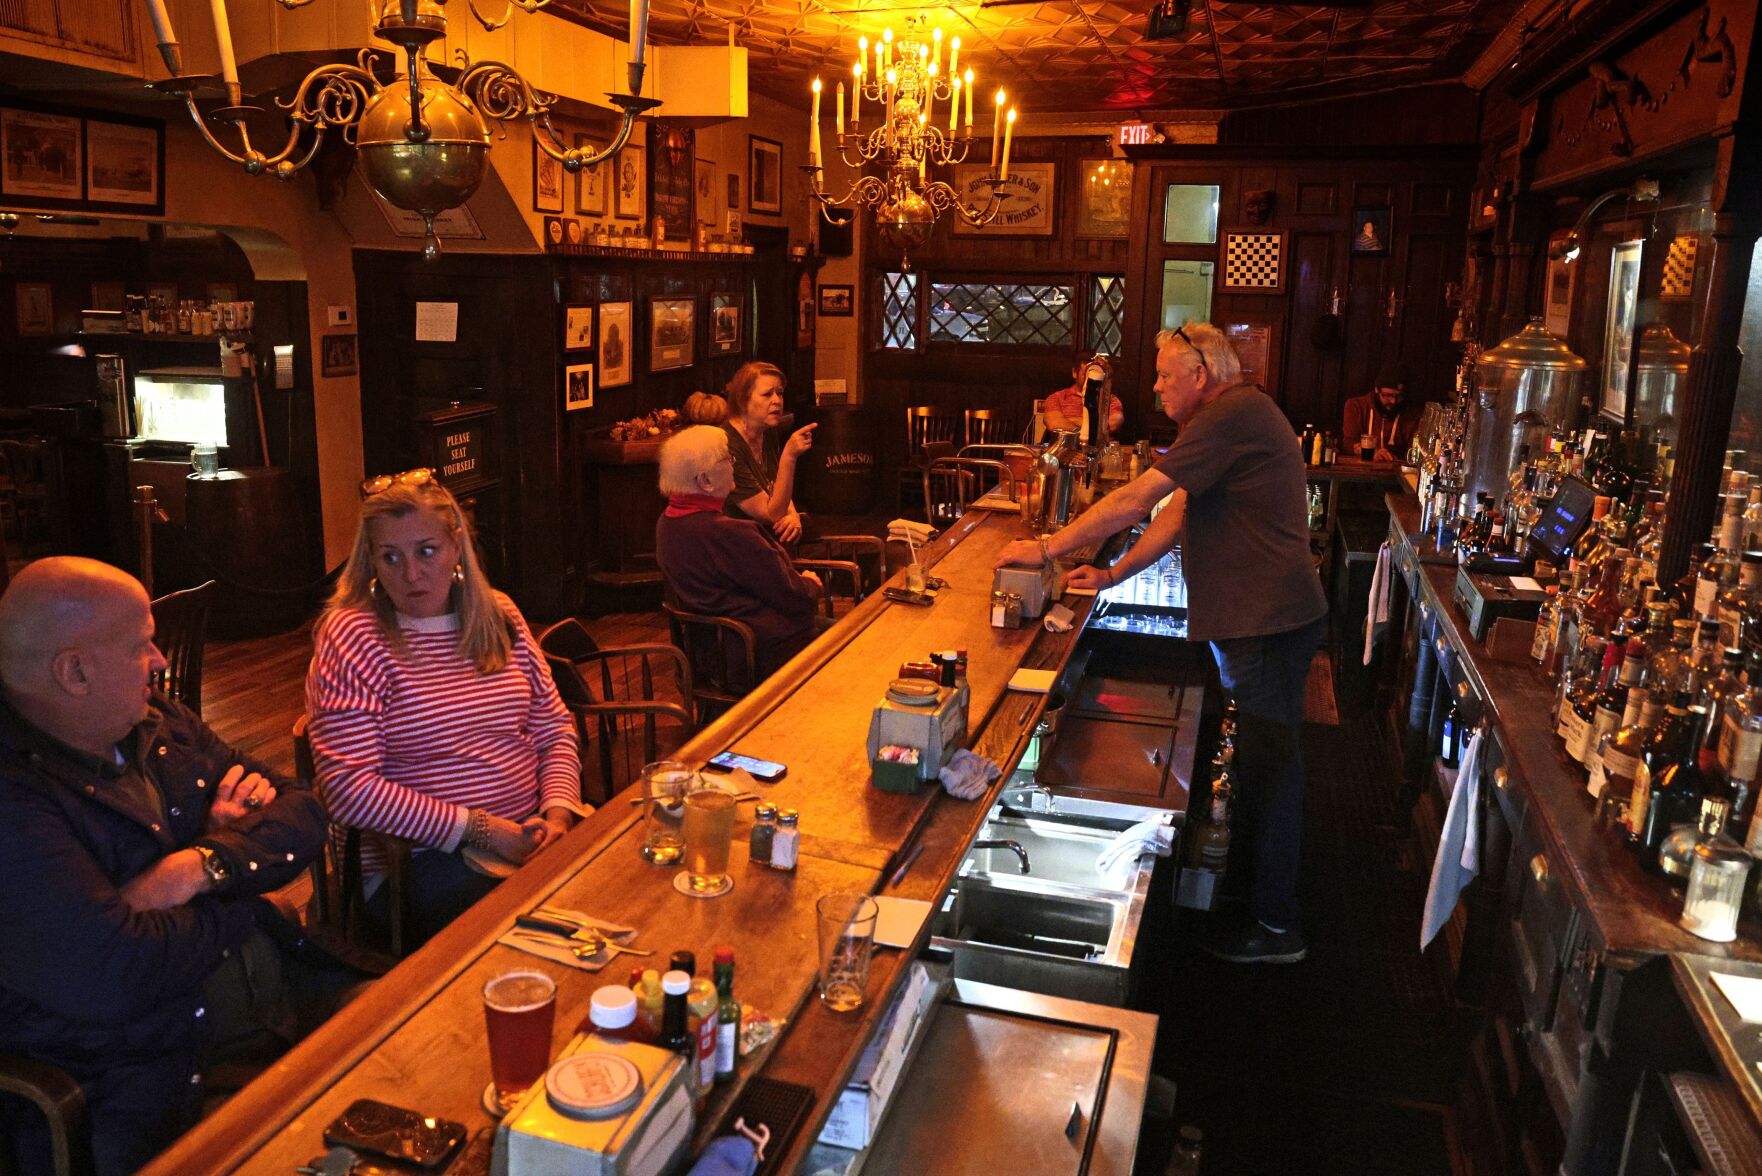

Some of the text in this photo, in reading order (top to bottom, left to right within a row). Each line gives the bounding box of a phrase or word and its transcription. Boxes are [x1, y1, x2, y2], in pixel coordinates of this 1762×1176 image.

[1120, 125, 1148, 145] EXIT
[1024, 177, 1041, 194] SON
[446, 432, 470, 447] PLEASE
[451, 446, 467, 460] SEAT
[443, 458, 476, 477] YOURSELF
